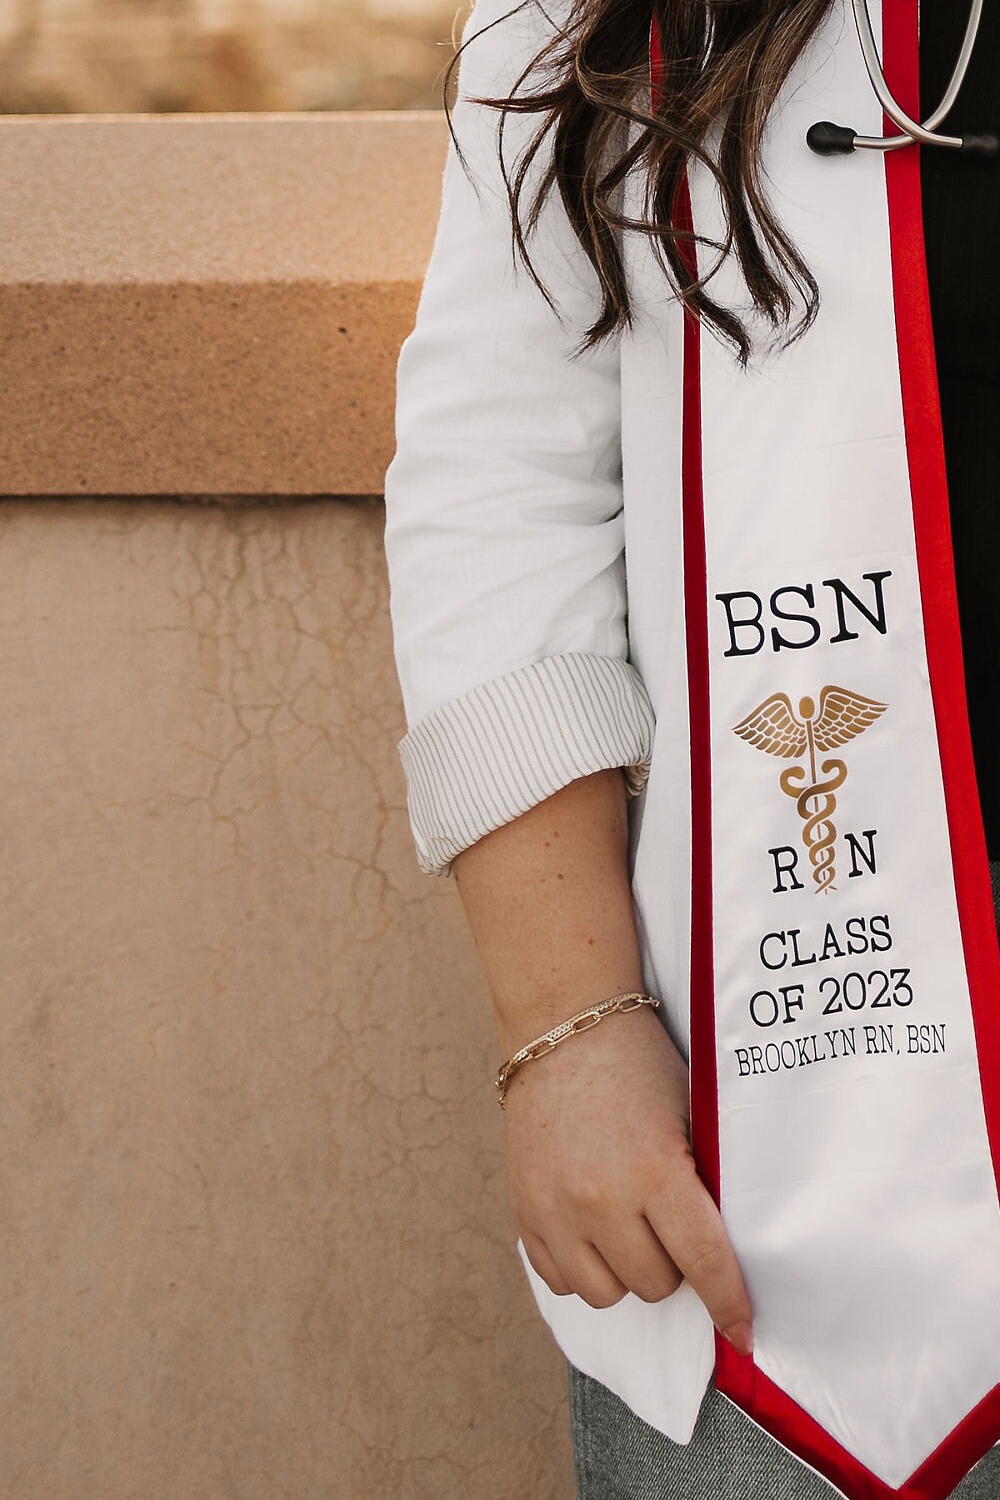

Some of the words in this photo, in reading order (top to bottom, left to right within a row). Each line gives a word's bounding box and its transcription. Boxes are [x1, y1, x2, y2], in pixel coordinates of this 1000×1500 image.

[715, 570, 893, 658] BSN
[759, 914, 893, 971] CLASS
[749, 984, 805, 1028] OF
[818, 968, 914, 1016] 2023
[734, 1027, 856, 1077] BROOKLYN
[862, 1024, 901, 1056] RN,
[906, 1023, 946, 1054] BSN
